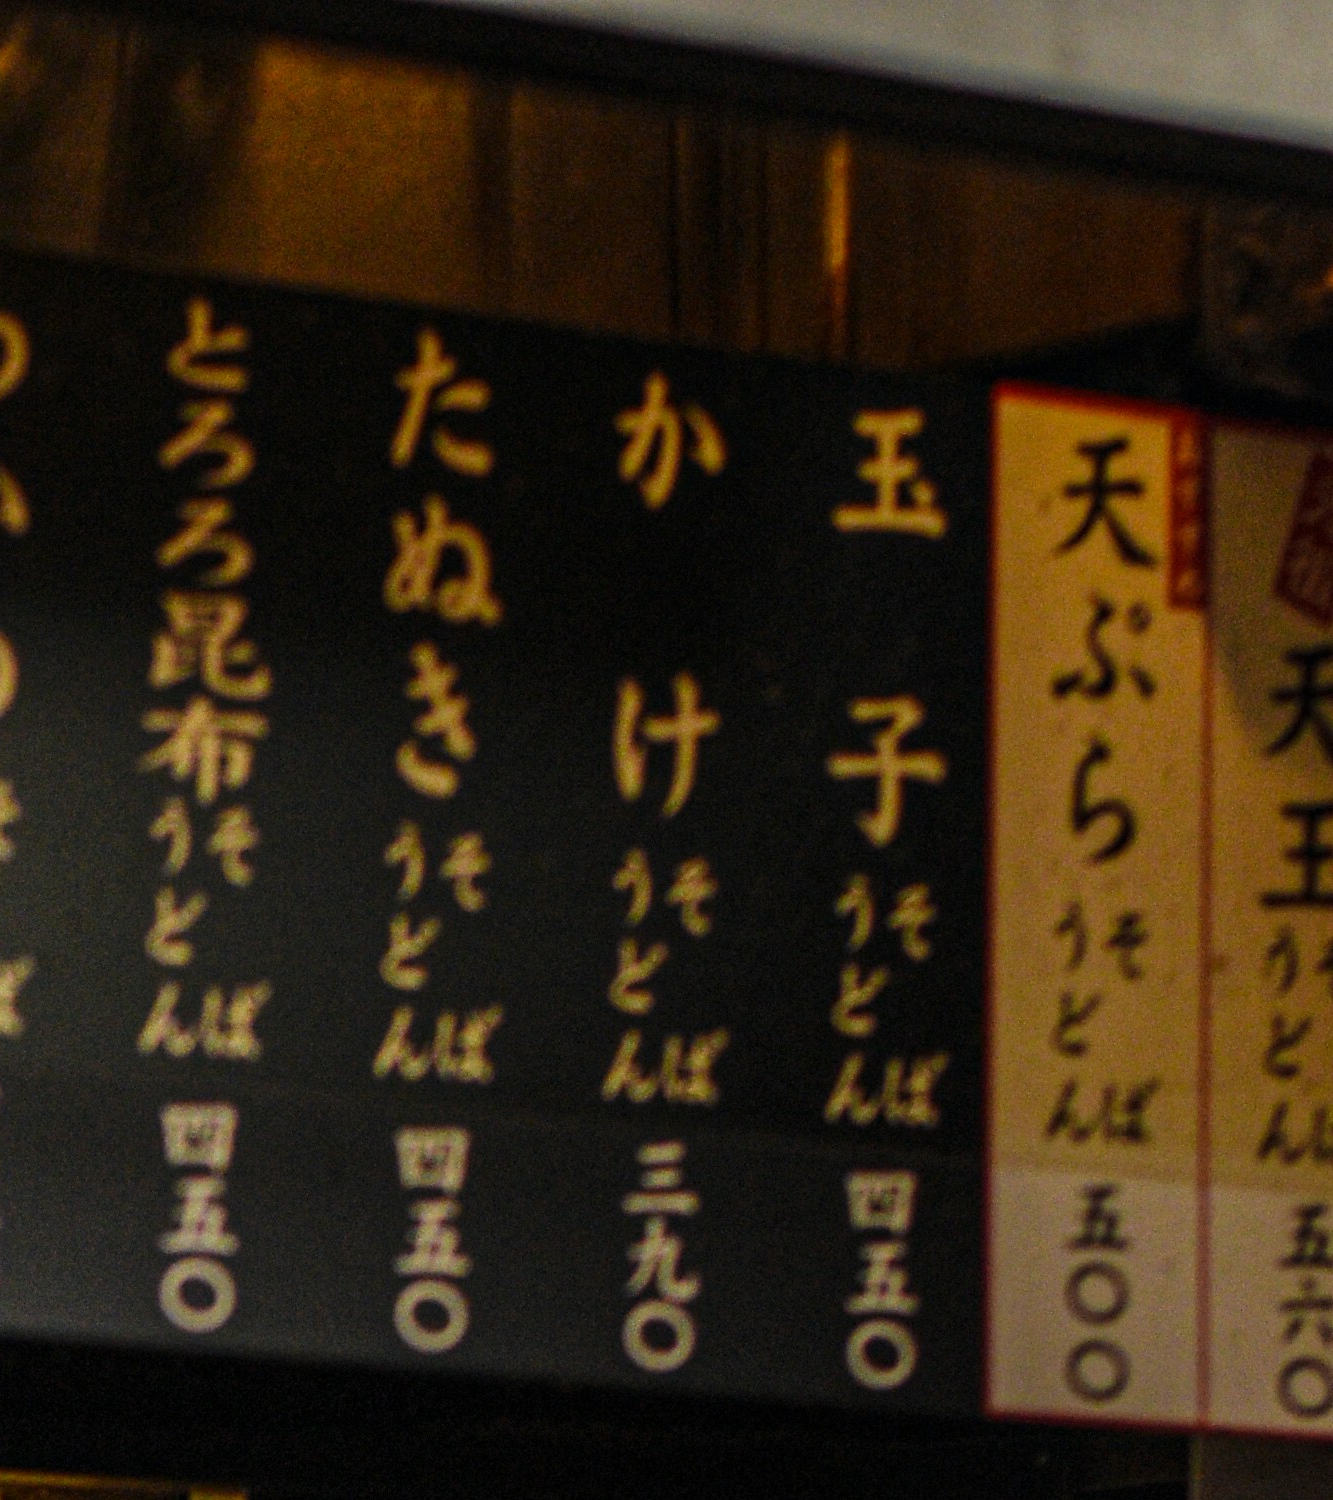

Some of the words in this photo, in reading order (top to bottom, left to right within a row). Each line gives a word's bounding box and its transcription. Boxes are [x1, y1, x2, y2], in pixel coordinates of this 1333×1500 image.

[139, 302, 270, 802] とろろ昆布
[387, 333, 499, 797] たぬき
[1052, 436, 1157, 863] 天ぷら
